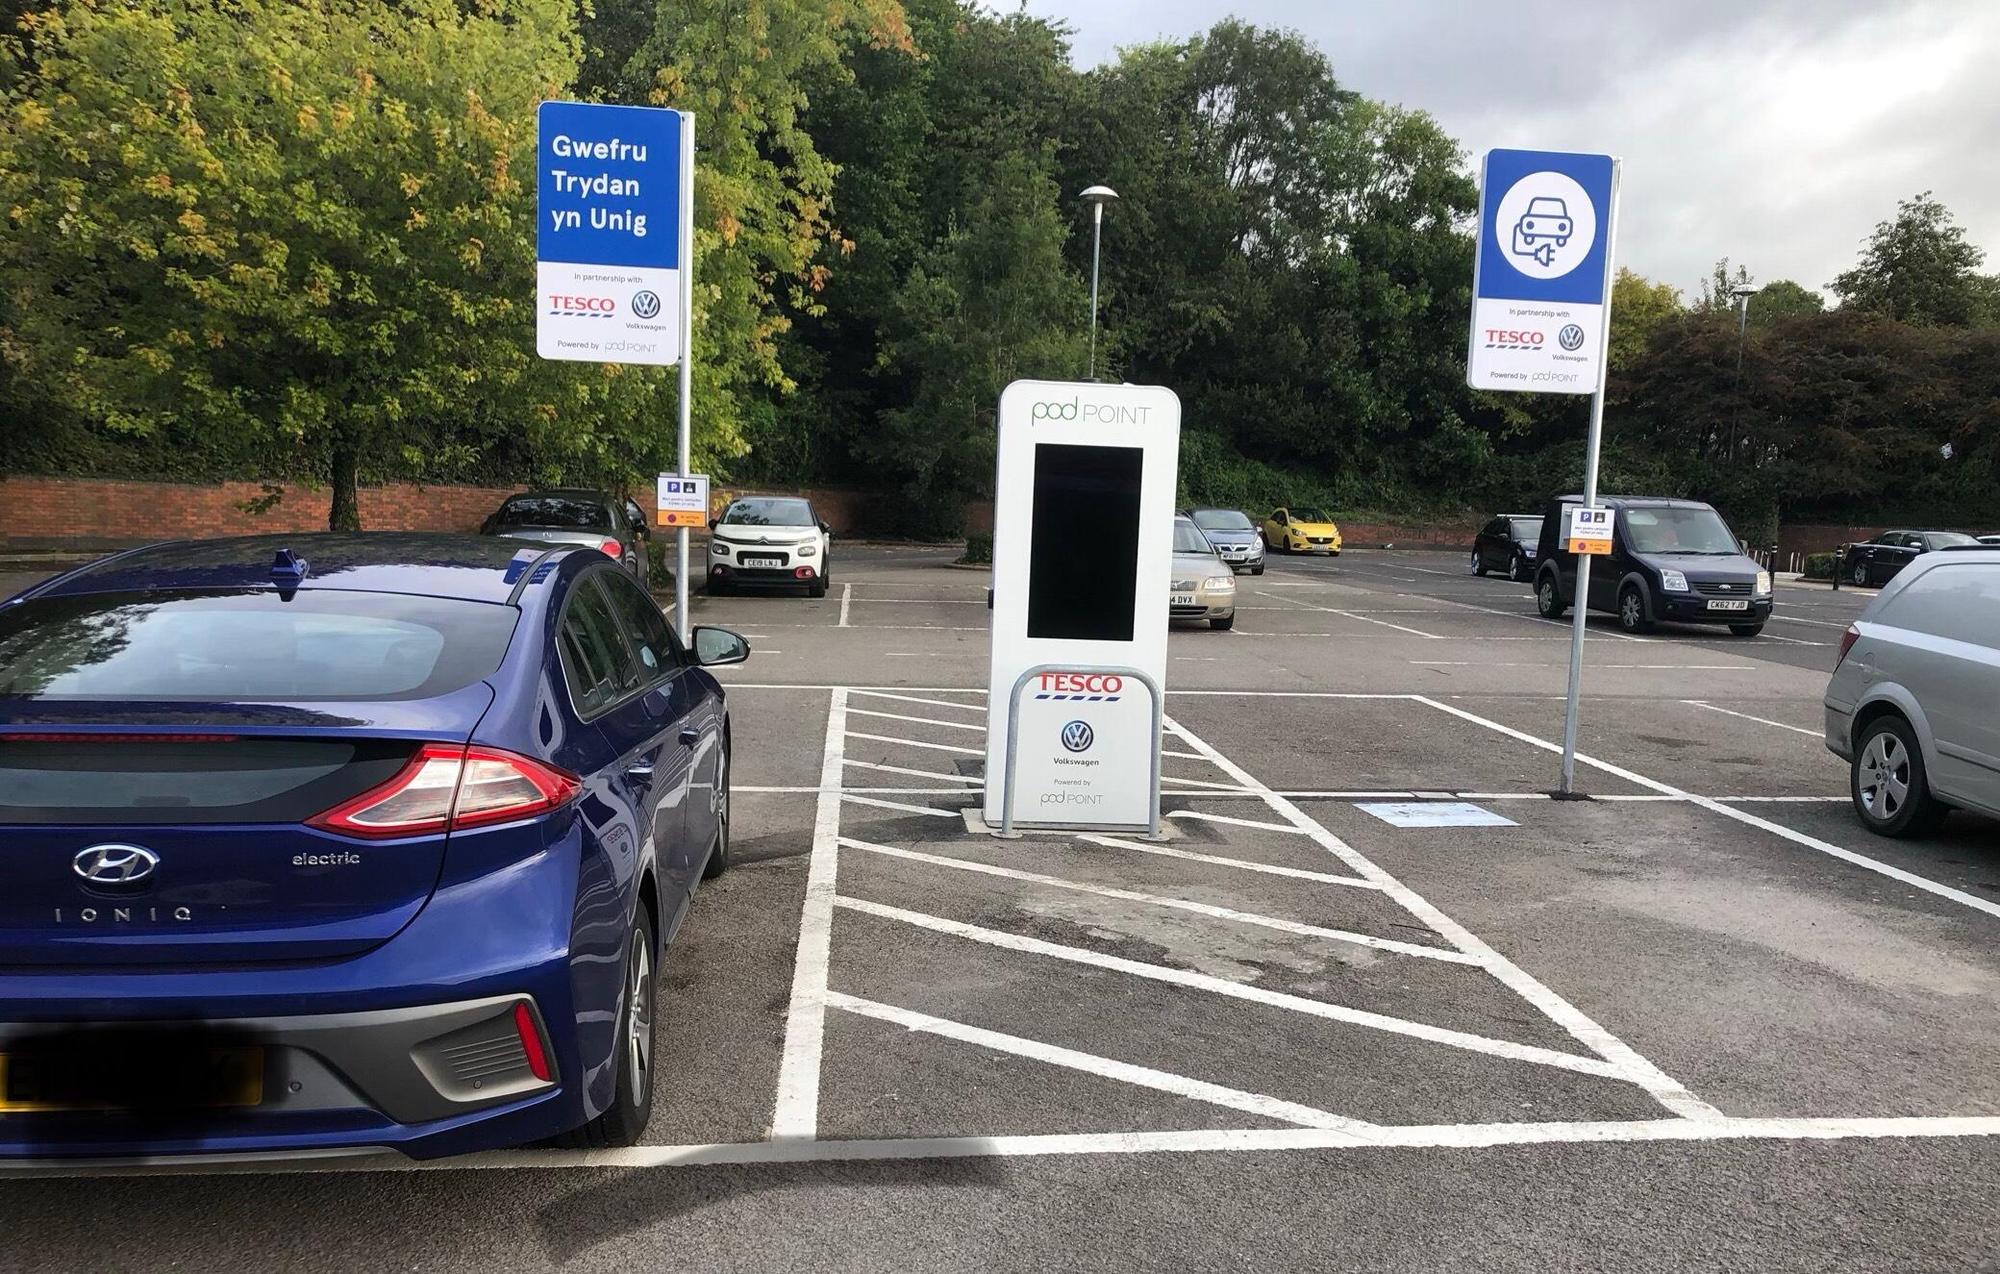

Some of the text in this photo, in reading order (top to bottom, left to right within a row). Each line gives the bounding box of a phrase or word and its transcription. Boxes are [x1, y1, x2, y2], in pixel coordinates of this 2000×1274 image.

[552, 135, 647, 162] Gwefru
[551, 170, 640, 198] Trydan
[551, 207, 647, 237] yn Unig
[582, 273, 626, 284] partnership
[627, 276, 643, 284] with
[549, 295, 615, 312] TESCO
[1516, 309, 1556, 318] partnership
[626, 322, 667, 332] Volkswagen
[1485, 329, 1544, 345] TESCO
[557, 340, 589, 349] Powered
[590, 341, 600, 350] by
[626, 343, 657, 352] POINT
[1552, 354, 1588, 363] Volkswagen
[1490, 371, 1518, 379] Powered
[1519, 372, 1528, 380] by
[1552, 373, 1578, 382] POINT
[1031, 395, 1152, 427] pod POINT
[1040, 672, 1123, 693] TESCO
[1053, 757, 1100, 767] Volkswagen
[1053, 778, 1091, 787] Powered by
[1066, 794, 1104, 805] POINT
[292, 851, 361, 866] electric
[55, 906, 192, 923] IONIQ
